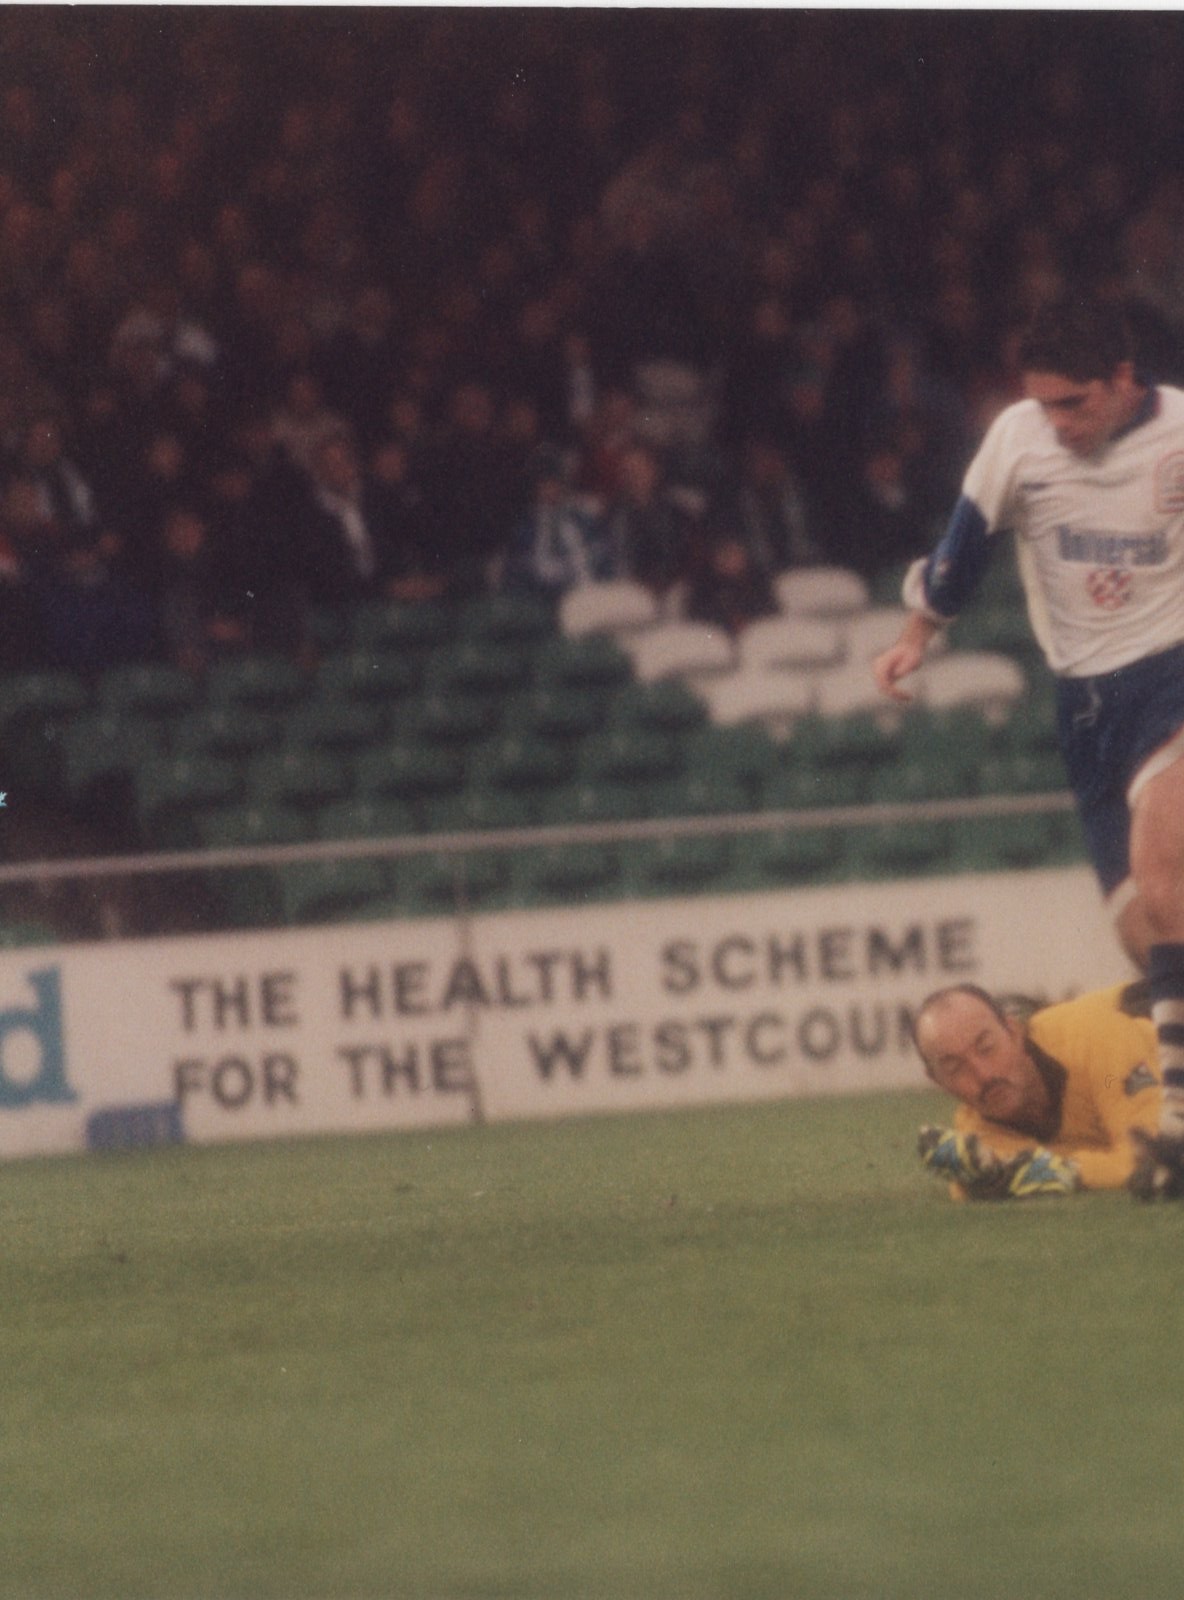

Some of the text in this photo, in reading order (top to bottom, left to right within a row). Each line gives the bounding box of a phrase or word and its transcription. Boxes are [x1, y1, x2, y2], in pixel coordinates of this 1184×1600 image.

[168, 917, 978, 1032] THE HEALTH SCHEME
[173, 1050, 300, 1109] FOR
[337, 1037, 476, 1099] THE
